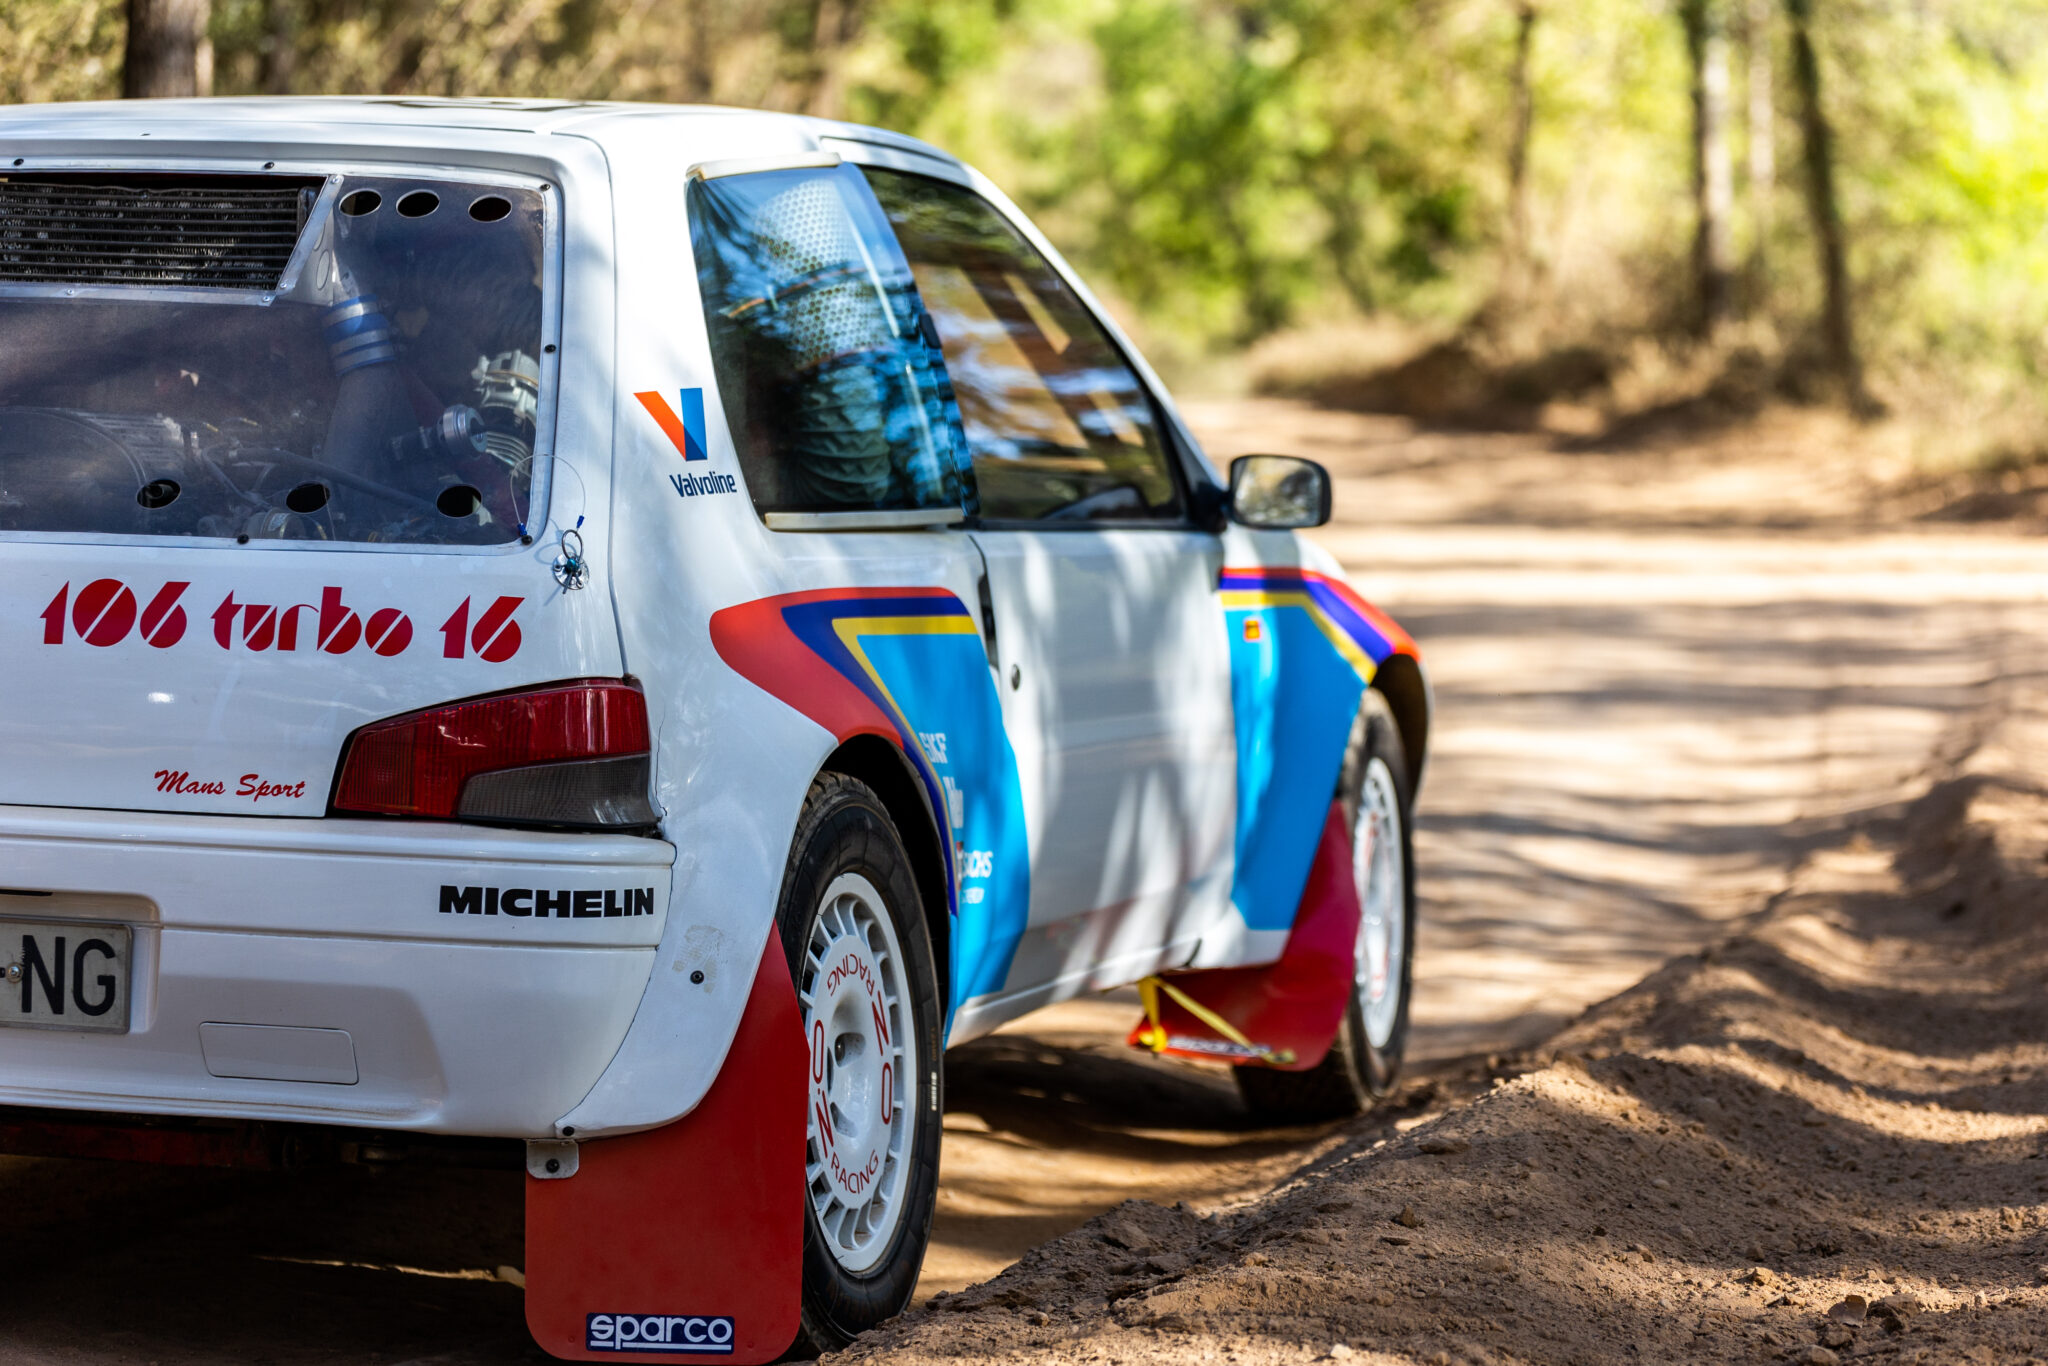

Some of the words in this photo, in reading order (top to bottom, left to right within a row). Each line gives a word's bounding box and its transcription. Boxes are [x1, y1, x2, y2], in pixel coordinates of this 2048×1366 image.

[669, 471, 737, 498] Valvoline
[40, 578, 192, 648] 106
[210, 586, 413, 657] turbo
[438, 595, 526, 663] 16
[154, 769, 226, 796] Mans
[235, 773, 306, 802] Sport
[439, 885, 655, 919] MICHELIN
[826, 953, 876, 997] RACING
[830, 1148, 879, 1195] RACING
[590, 1314, 733, 1350] sparco
